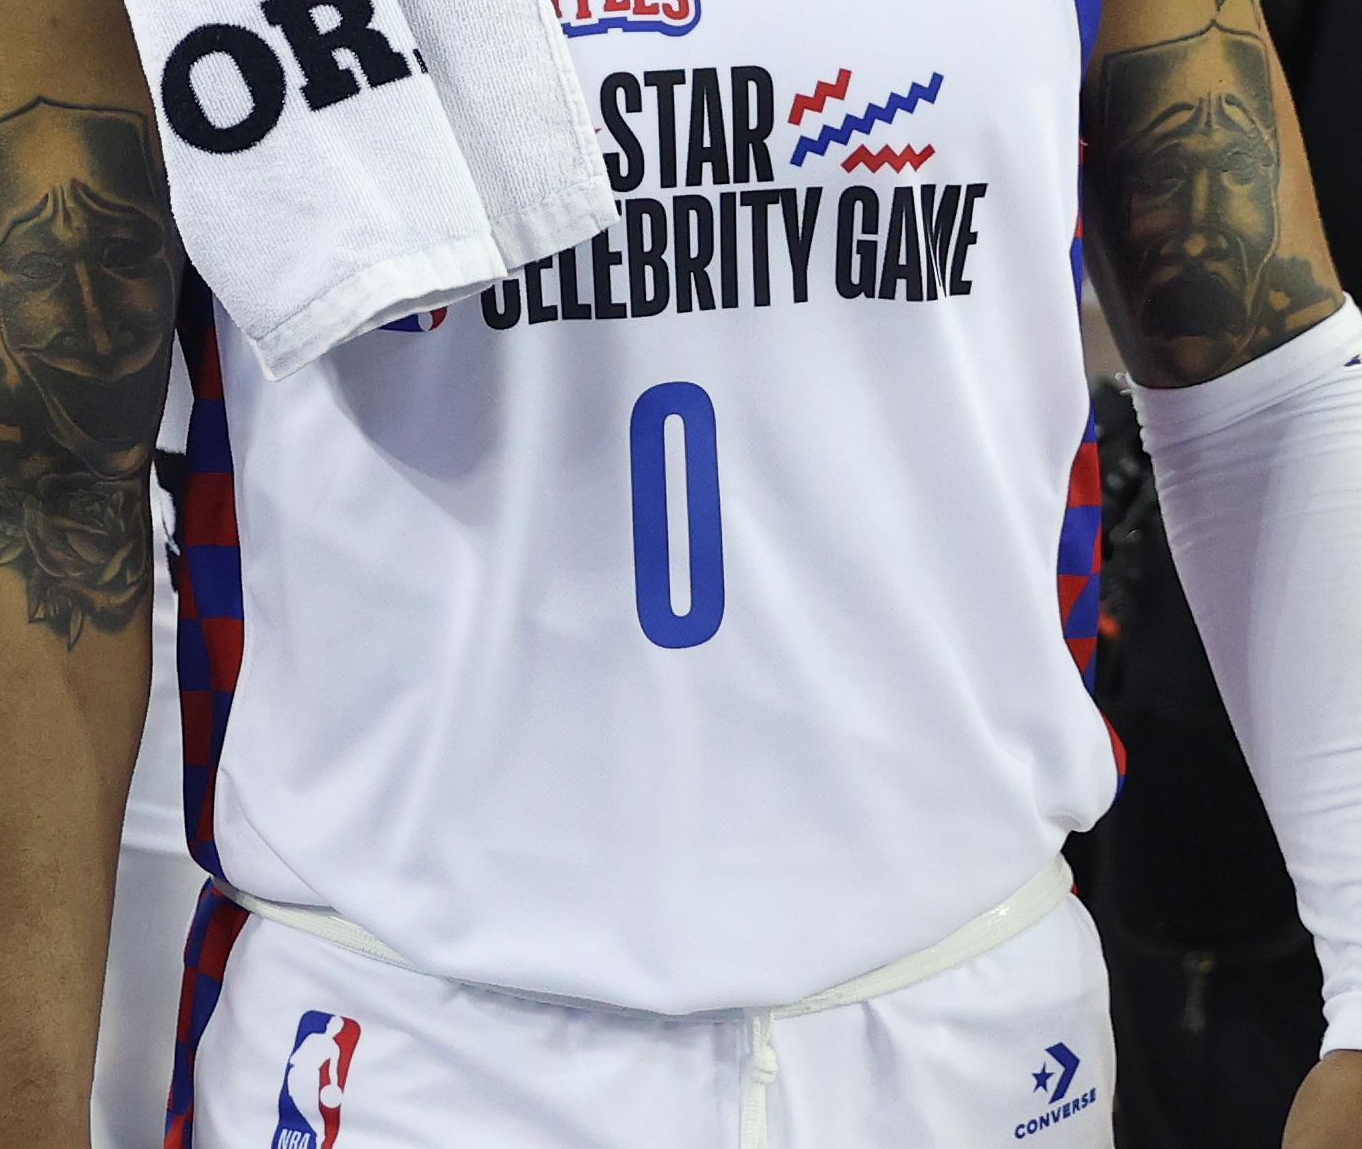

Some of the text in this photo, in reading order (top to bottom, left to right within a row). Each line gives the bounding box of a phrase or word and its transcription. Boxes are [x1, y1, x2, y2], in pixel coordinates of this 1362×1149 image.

[599, 65, 775, 193] STAR
[629, 380, 726, 650] 0
[1014, 1087, 1097, 1140] CONVERSE
